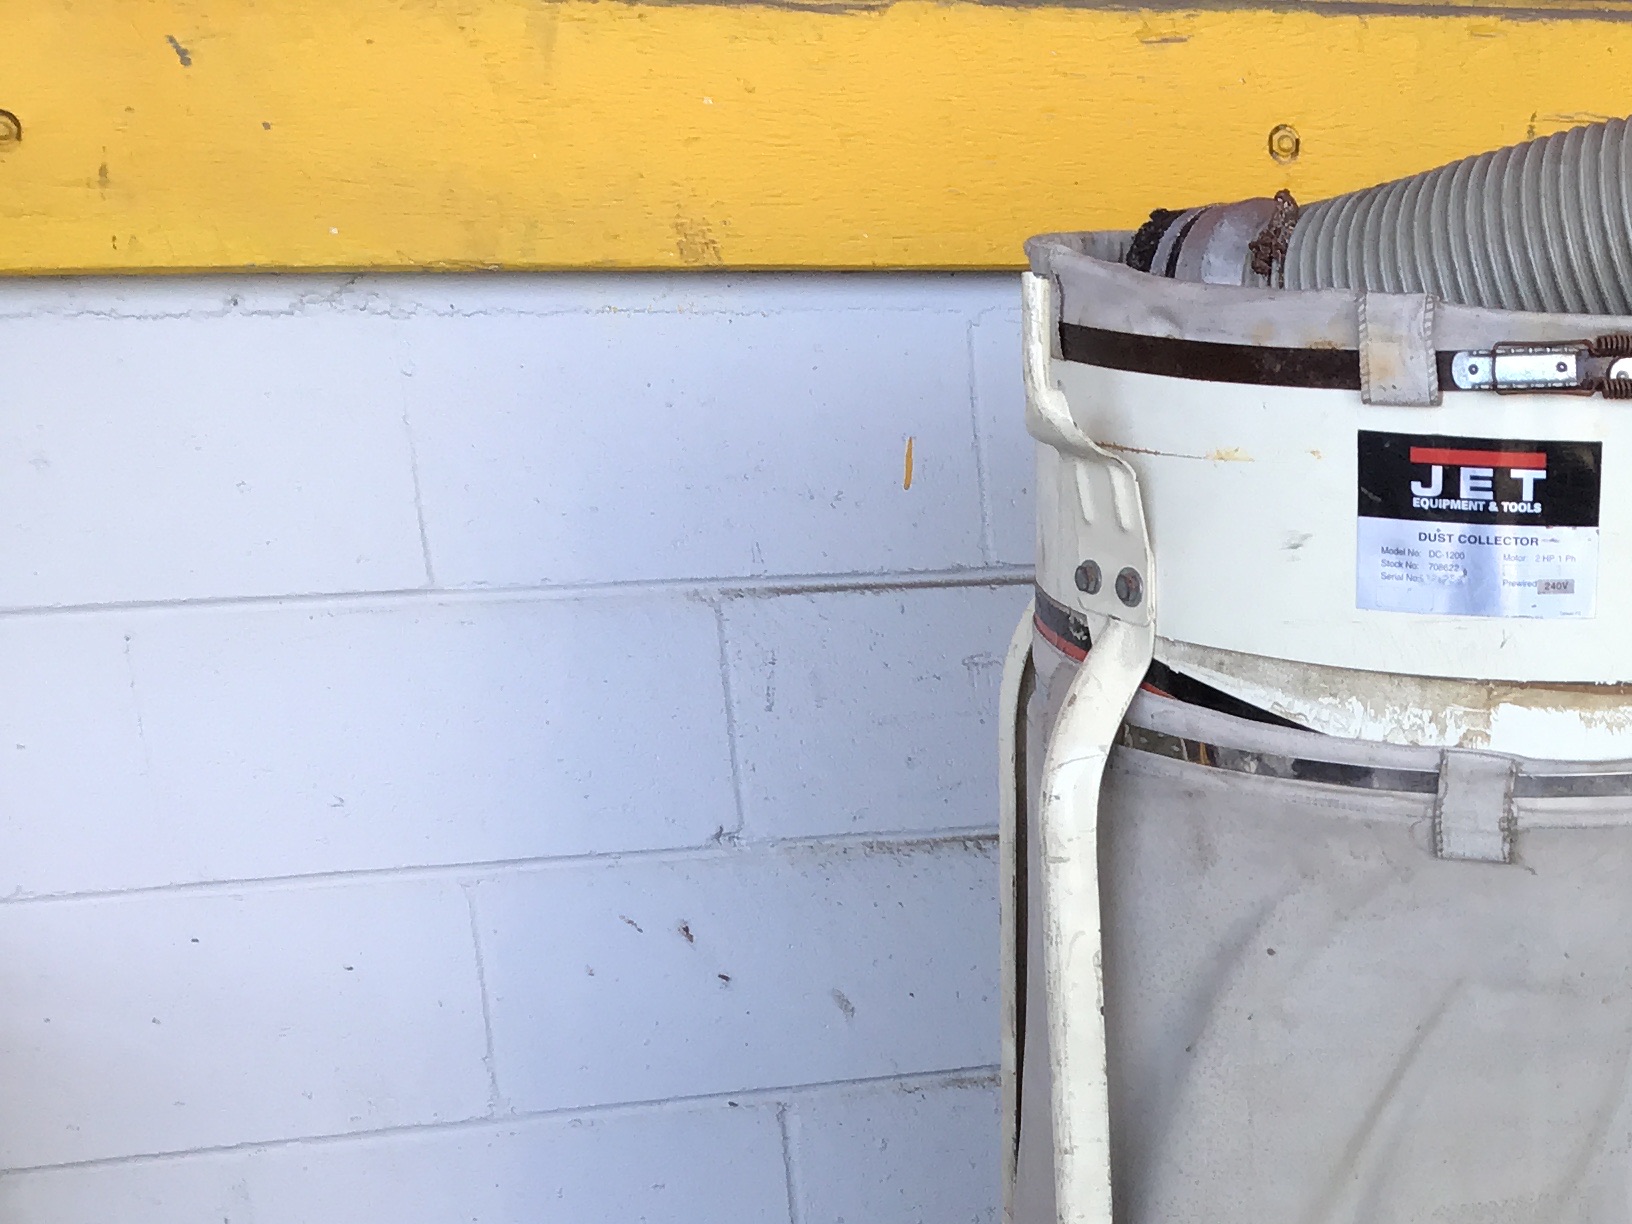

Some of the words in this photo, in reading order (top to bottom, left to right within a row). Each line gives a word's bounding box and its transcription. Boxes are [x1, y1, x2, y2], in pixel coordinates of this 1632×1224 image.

[1410, 465, 1547, 502] JET
[1412, 498, 1486, 512] EQUIPMENT
[1488, 500, 1499, 512] &
[1501, 501, 1542, 514] TOOLS
[1418, 532, 1454, 543] DUST
[1458, 534, 1539, 546] COLLECTOR
[1380, 546, 1406, 556] Model
[1535, 554, 1541, 563] 2
[1542, 554, 1555, 563] HP
[1565, 555, 1576, 563] Ph
[1380, 559, 1404, 569] Stock
[1380, 571, 1404, 581] Serial
[1544, 581, 1569, 591] 240V
